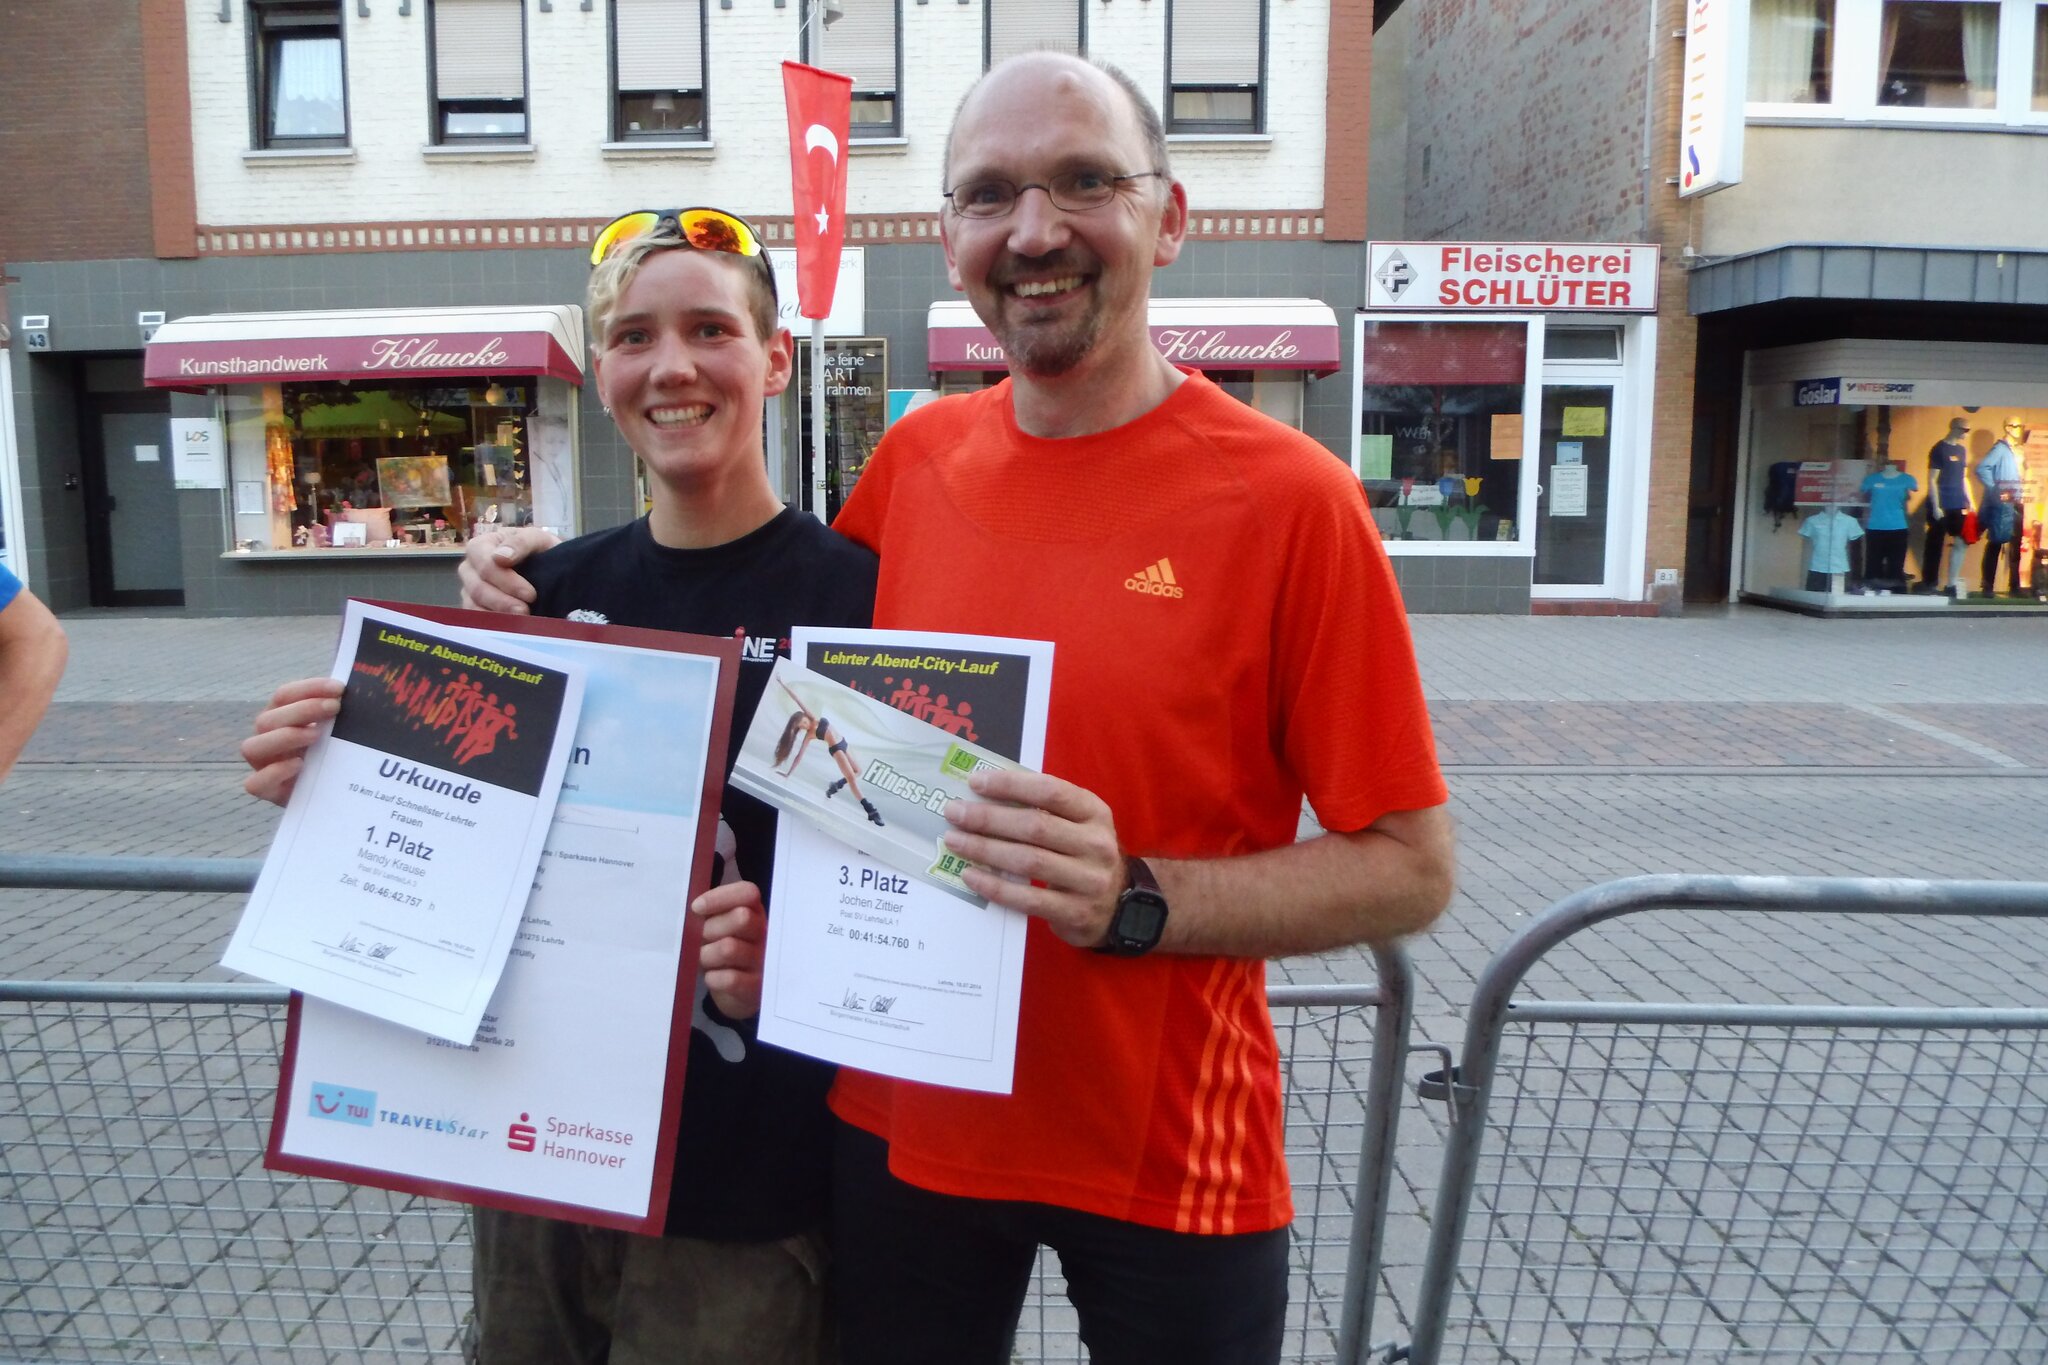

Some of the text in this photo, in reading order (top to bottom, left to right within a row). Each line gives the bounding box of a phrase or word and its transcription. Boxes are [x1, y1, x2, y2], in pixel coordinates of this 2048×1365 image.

[1441, 247, 1631, 273] Fleischerei
[1438, 275, 1632, 306] SCHLÜTER
[29, 334, 46, 347] 43
[1157, 330, 1300, 361] Klaucke
[180, 336, 509, 374] Kunsthandwerk Klaucke
[823, 352, 865, 366] ie feine
[823, 368, 855, 381] ART
[826, 383, 872, 396] rahmen
[1799, 384, 1837, 405] Goslar
[1857, 383, 1914, 393] INTERSPORT
[185, 430, 209, 443] LOS
[1124, 578, 1184, 599] adidas
[379, 629, 543, 685] Lehrter Abend-City-Lauf
[823, 651, 999, 675] Lehrter Abend-City-Lauf
[378, 757, 482, 804] Urkunde
[389, 810, 424, 828] Frauen
[365, 825, 435, 861] 1. Platz
[357, 847, 427, 877] Mandy Krause
[559, 851, 598, 864] Sparkasse
[598, 856, 636, 868] Hannover
[838, 865, 909, 895] 3. Platz
[839, 893, 873, 909] Jochen
[848, 928, 910, 949] 00:41:54.760
[347, 1103, 369, 1119] TUI
[546, 1116, 634, 1146] Sparkasse
[542, 1140, 626, 1169] Hannover
